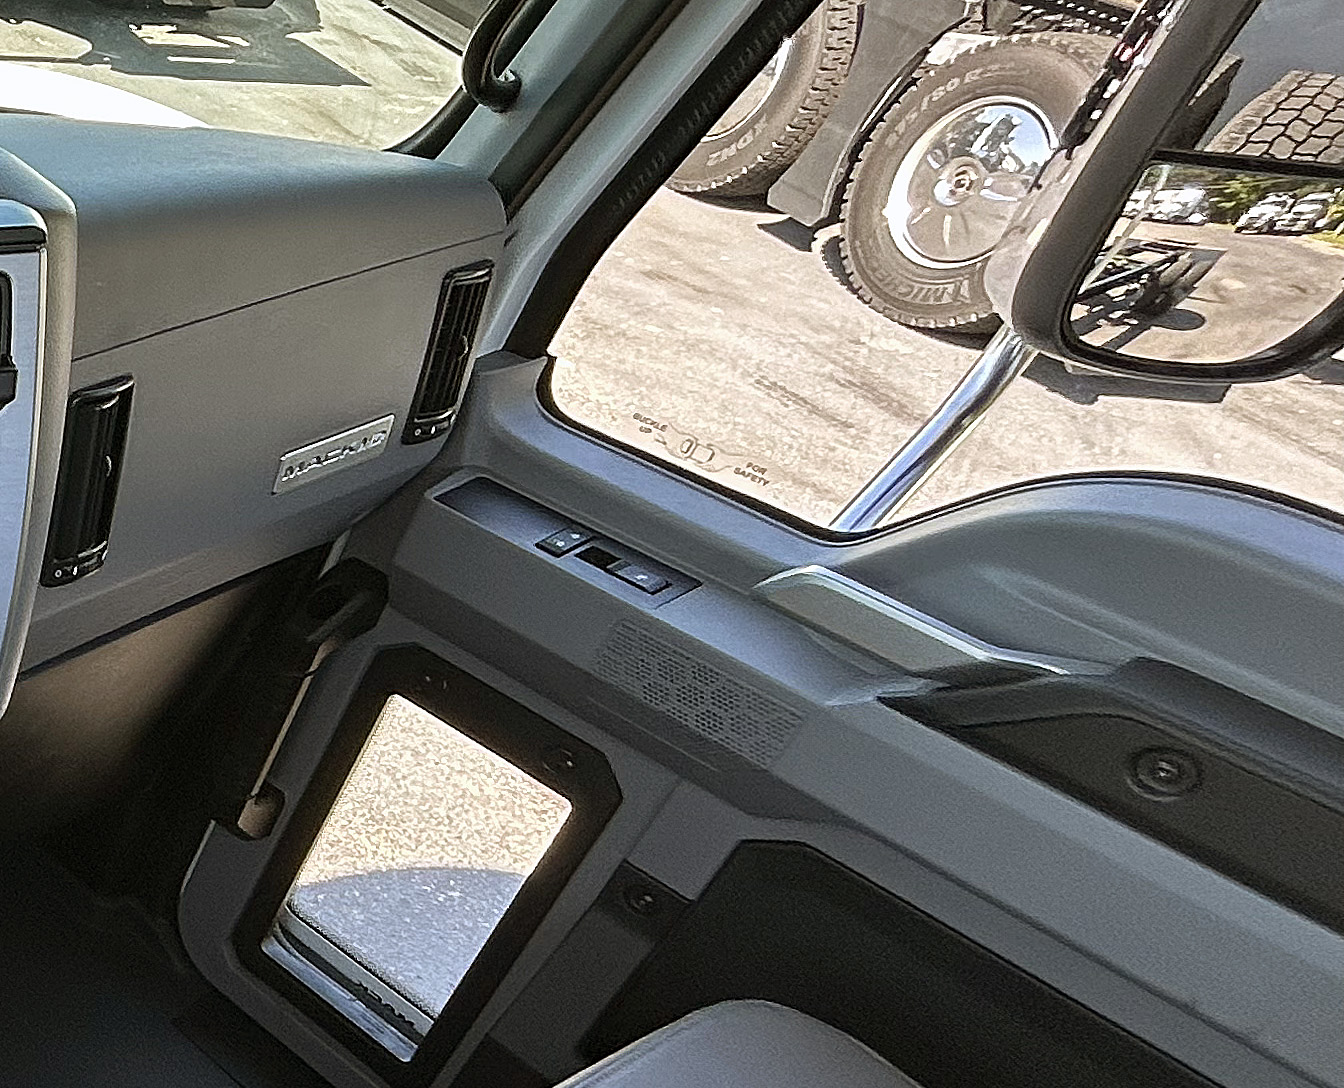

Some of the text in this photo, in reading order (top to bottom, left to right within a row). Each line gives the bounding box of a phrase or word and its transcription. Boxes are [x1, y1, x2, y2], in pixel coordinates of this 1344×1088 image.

[633, 412, 668, 433] BUCKLE
[733, 467, 770, 486] SAFETY
[746, 461, 768, 476] FOR
